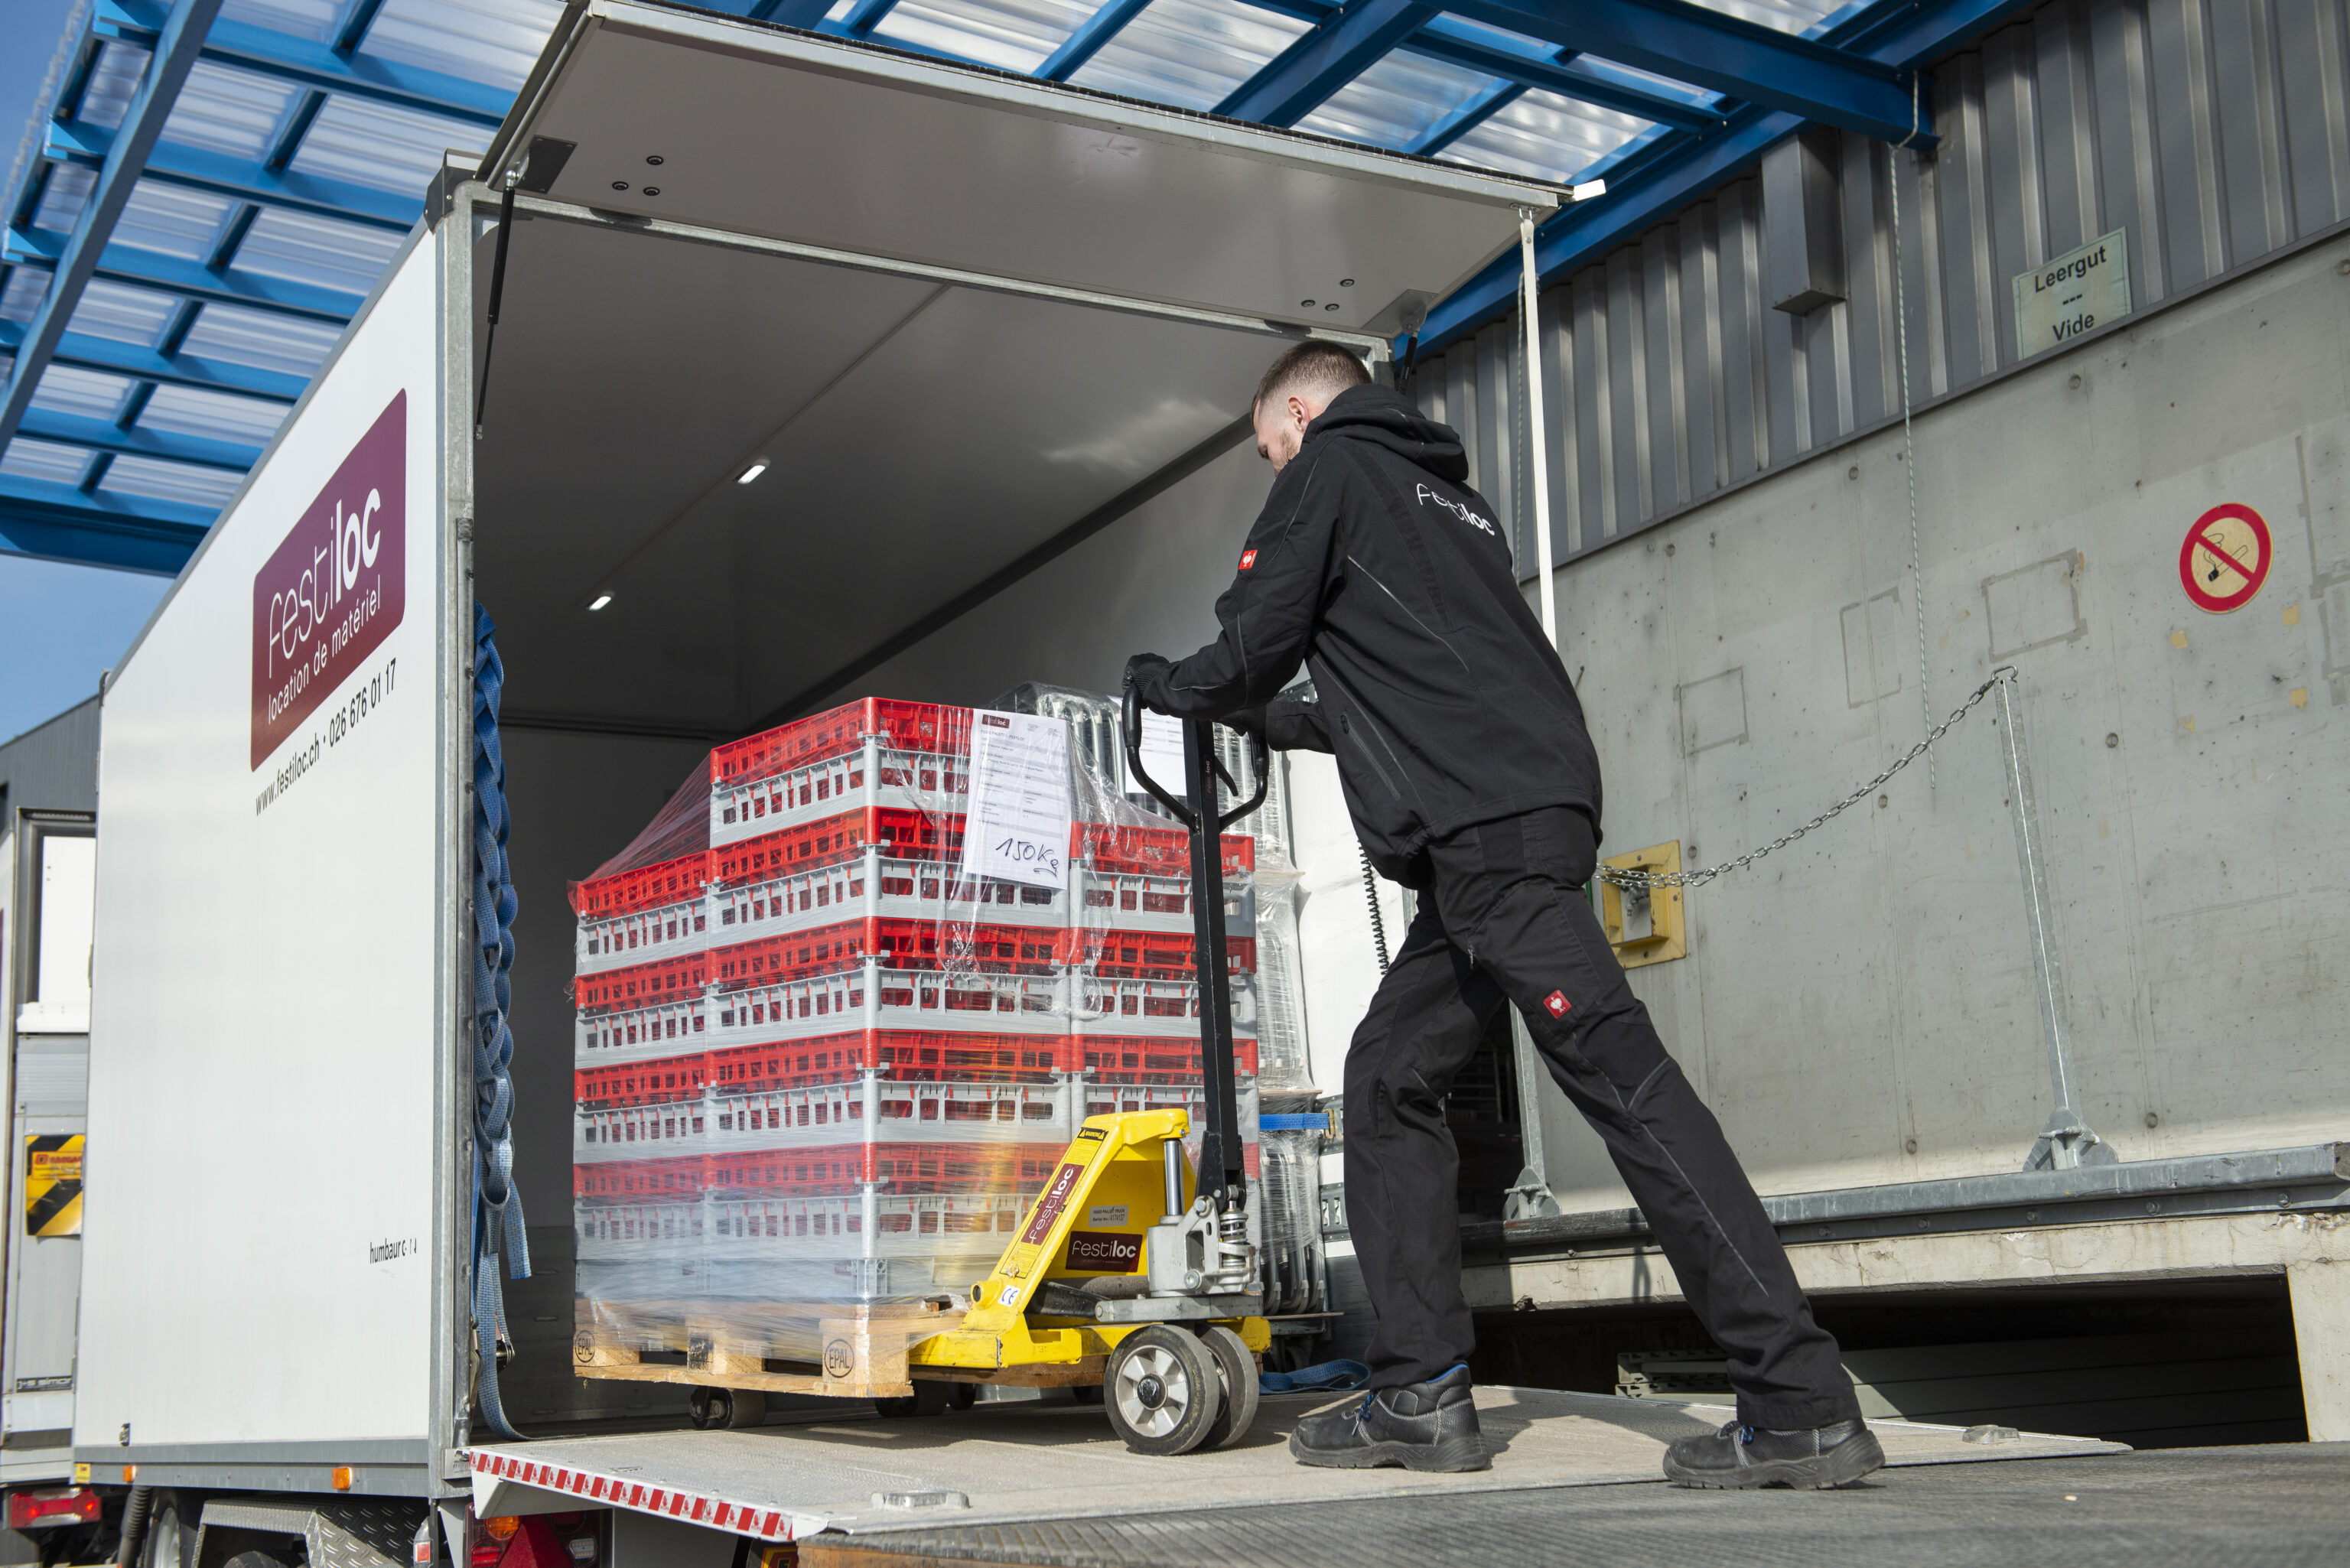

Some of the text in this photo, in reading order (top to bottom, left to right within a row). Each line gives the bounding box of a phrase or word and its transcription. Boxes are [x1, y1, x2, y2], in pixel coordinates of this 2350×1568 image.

[2034, 245, 2107, 293] Leergut
[2052, 314, 2095, 341] Vide
[1416, 483, 1495, 536] fetiloc
[269, 488, 381, 679] festiloc
[268, 574, 380, 725] location de matériel
[256, 732, 320, 817] www.festiloc.ch
[329, 706, 347, 748] 026
[350, 686, 367, 728] 676
[370, 672, 381, 708] 01
[386, 657, 396, 695] 17
[1029, 1167, 1074, 1240] festiloc
[369, 1238, 401, 1264] humbaur
[1072, 1240, 1137, 1258] festiloc
[578, 1337, 593, 1355] EPAL
[829, 1348, 850, 1369] EPAL
